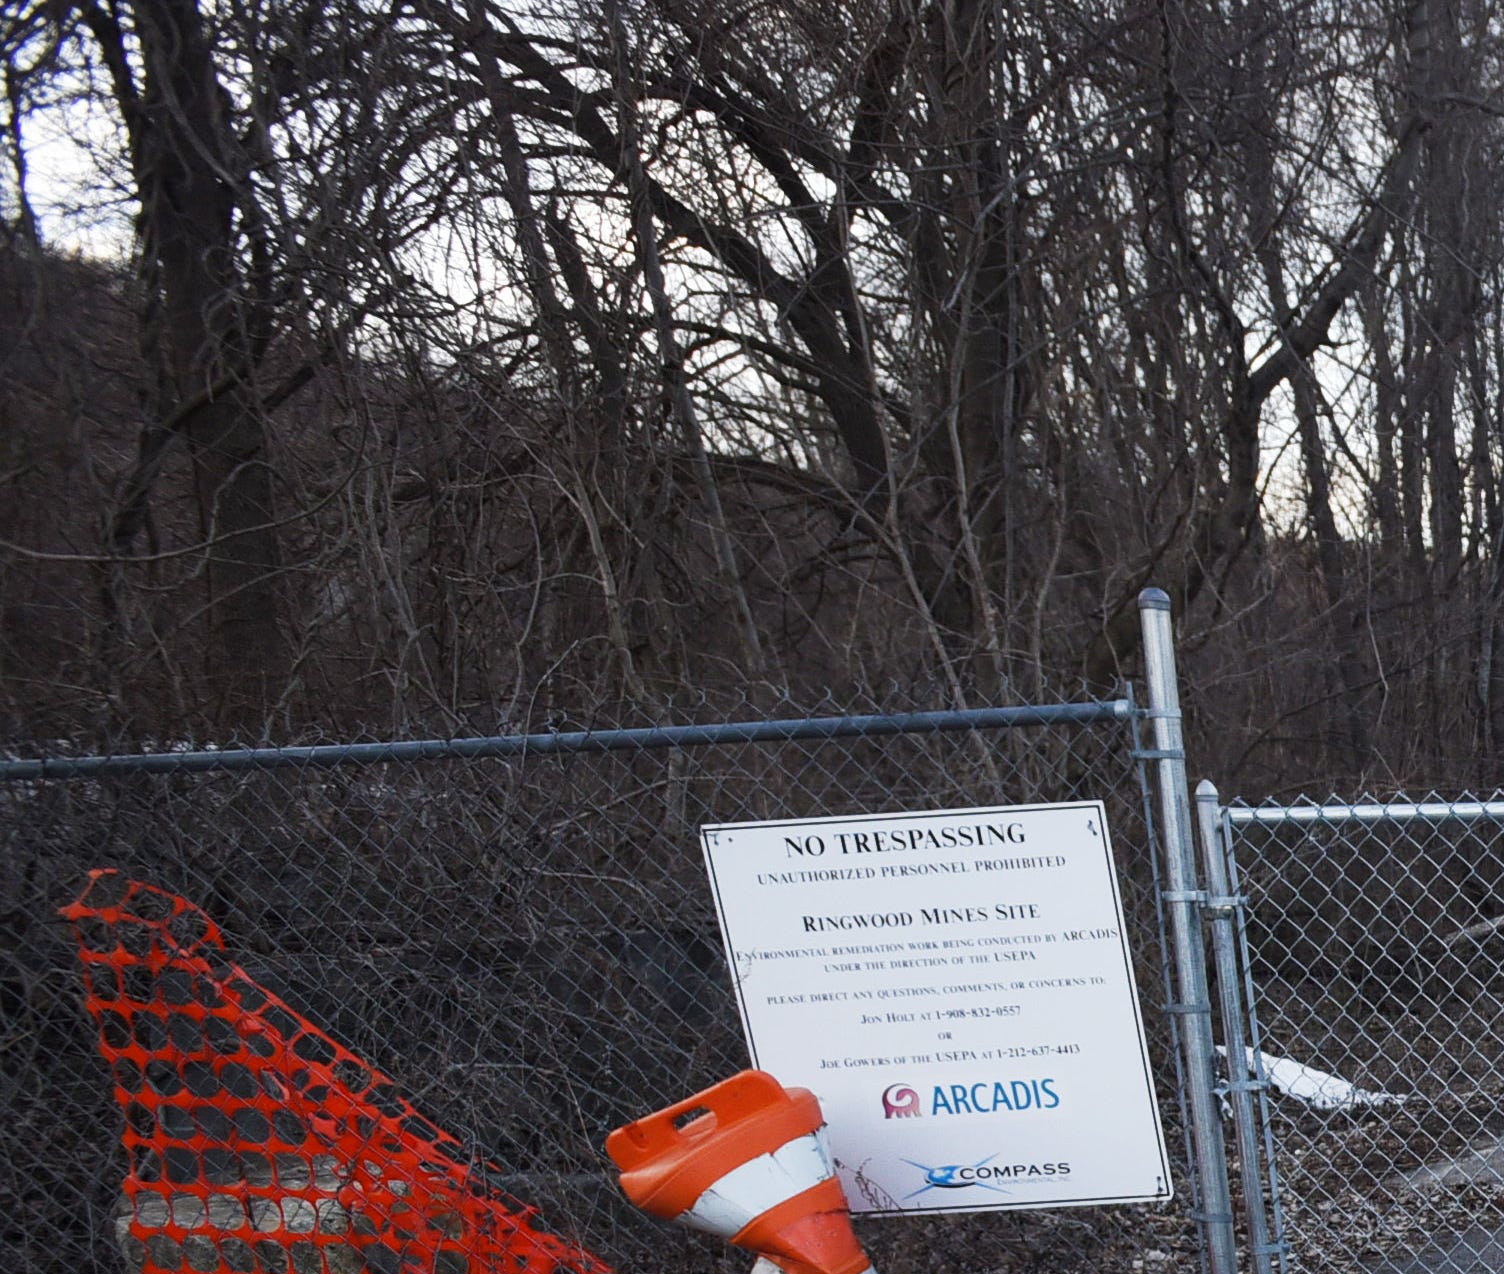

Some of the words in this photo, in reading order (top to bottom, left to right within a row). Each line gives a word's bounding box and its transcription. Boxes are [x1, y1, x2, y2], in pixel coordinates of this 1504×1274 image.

[783, 835, 825, 858] NO
[834, 823, 1026, 855] TRESPASSING
[757, 867, 876, 885] UNAUTHORIZED
[881, 862, 970, 878] PERSONNEL
[974, 855, 1066, 872] PROHIBITED
[802, 911, 913, 932] RINGWOOD
[920, 907, 988, 925] MINES
[995, 903, 1041, 921] SITE
[832, 943, 905, 956] REMEDIATION
[908, 941, 939, 951] WORK
[943, 938, 975, 949] BEING
[978, 935, 1041, 947] CONDUCTED
[1045, 933, 1057, 943] BY
[1063, 928, 1118, 941] ARCADIS
[824, 962, 861, 973] UNDER
[865, 961, 886, 971] THE
[890, 956, 948, 969] DIRECTION
[952, 956, 965, 965] OF
[969, 955, 990, 964] THE
[994, 950, 1036, 962] USEPA
[766, 994, 806, 1005] PLEASE
[810, 992, 848, 1003] DIRECT
[852, 989, 873, 1000] ANY
[877, 986, 941, 998] QUESTIONS,
[943, 983, 1007, 995] COMMENTS,
[1010, 981, 1025, 990] OR
[1029, 978, 1086, 989] CONCERNS
[860, 1014, 882, 1025] JON
[886, 1011, 915, 1023] HOLT
[920, 1011, 932, 1021] AT
[935, 1005, 1021, 1020] 1-908-832-0557
[938, 1031, 952, 1040] OR
[820, 1058, 839, 1069] JOE
[844, 1056, 891, 1068] GOWERS
[893, 1056, 907, 1065] OF
[911, 1054, 932, 1064] THE
[936, 1050, 977, 1063] USEPA
[981, 1051, 994, 1060] AT
[997, 1044, 1081, 1059] 1-212-637-4413
[931, 1078, 1060, 1116] ARCADIS
[959, 1162, 1071, 1180] COMPASS
